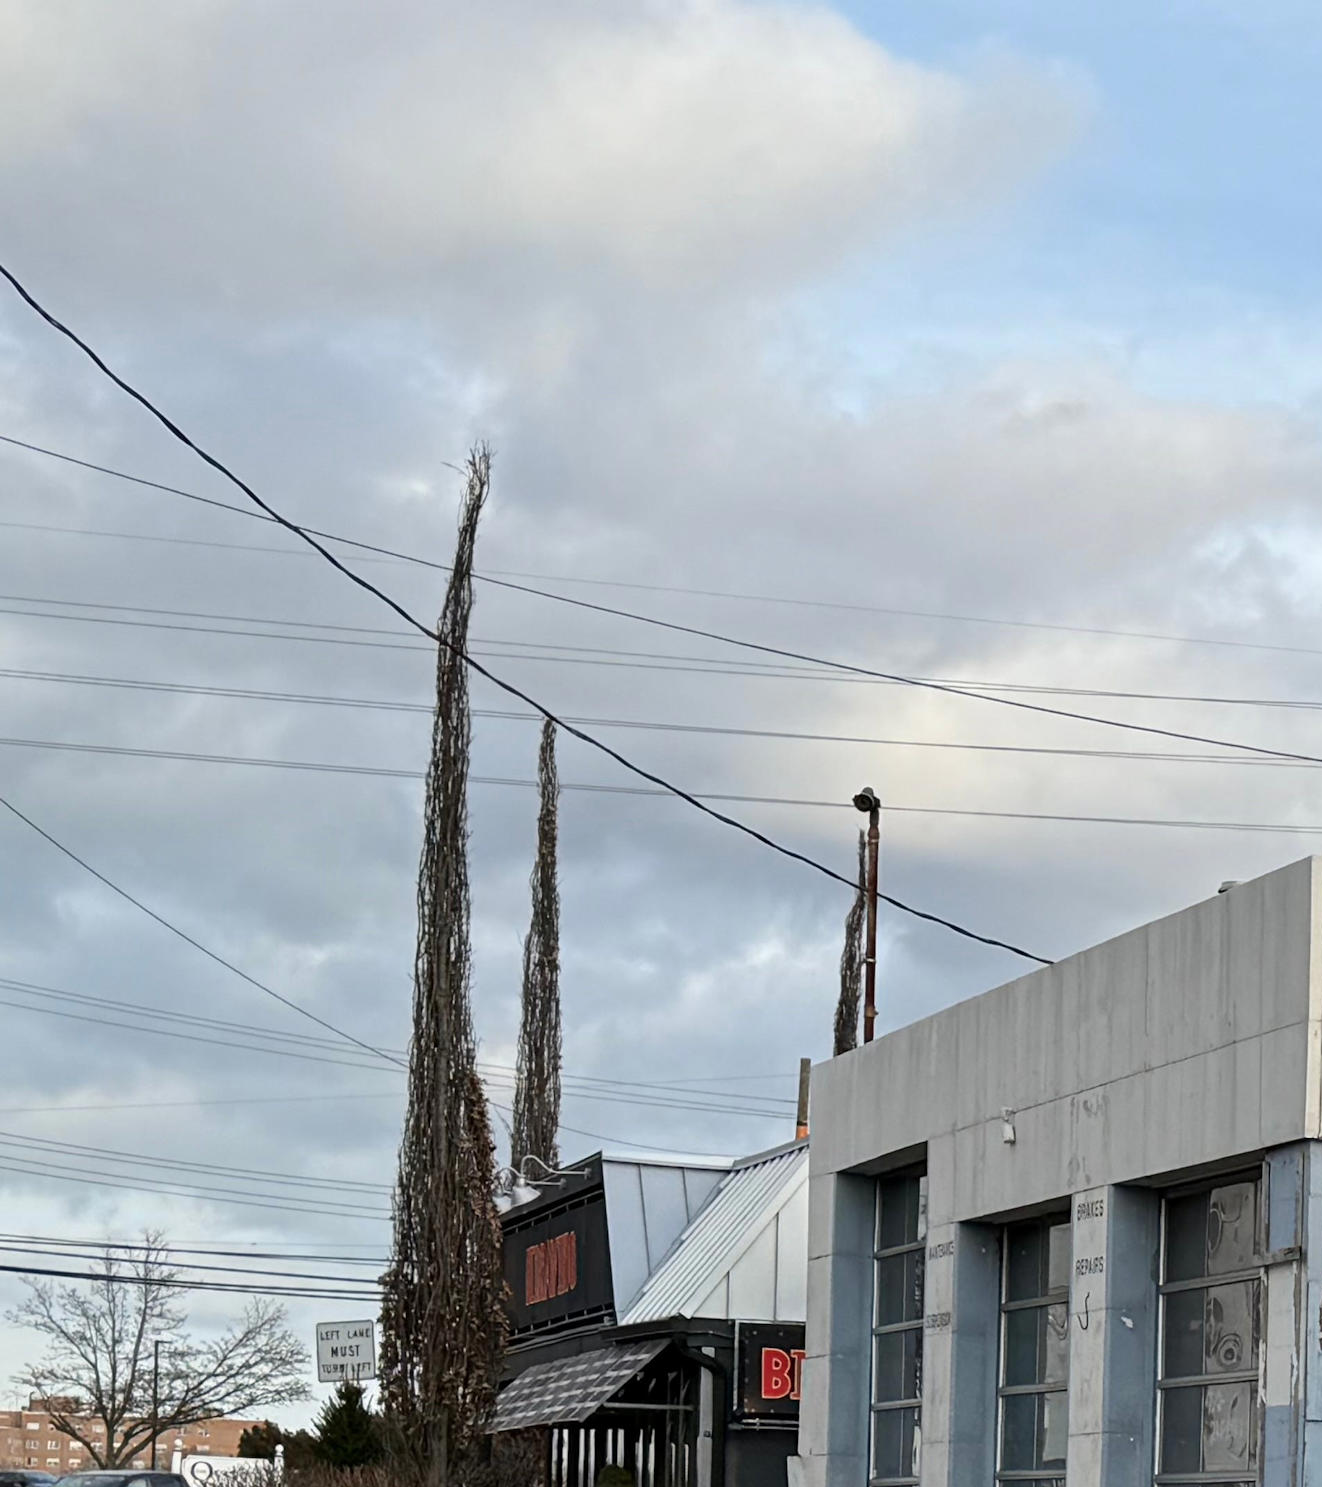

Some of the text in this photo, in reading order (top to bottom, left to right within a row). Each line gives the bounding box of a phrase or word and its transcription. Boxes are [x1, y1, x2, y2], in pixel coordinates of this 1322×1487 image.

[320, 1327, 371, 1341] LEFT LANE
[331, 1344, 360, 1358] MUST
